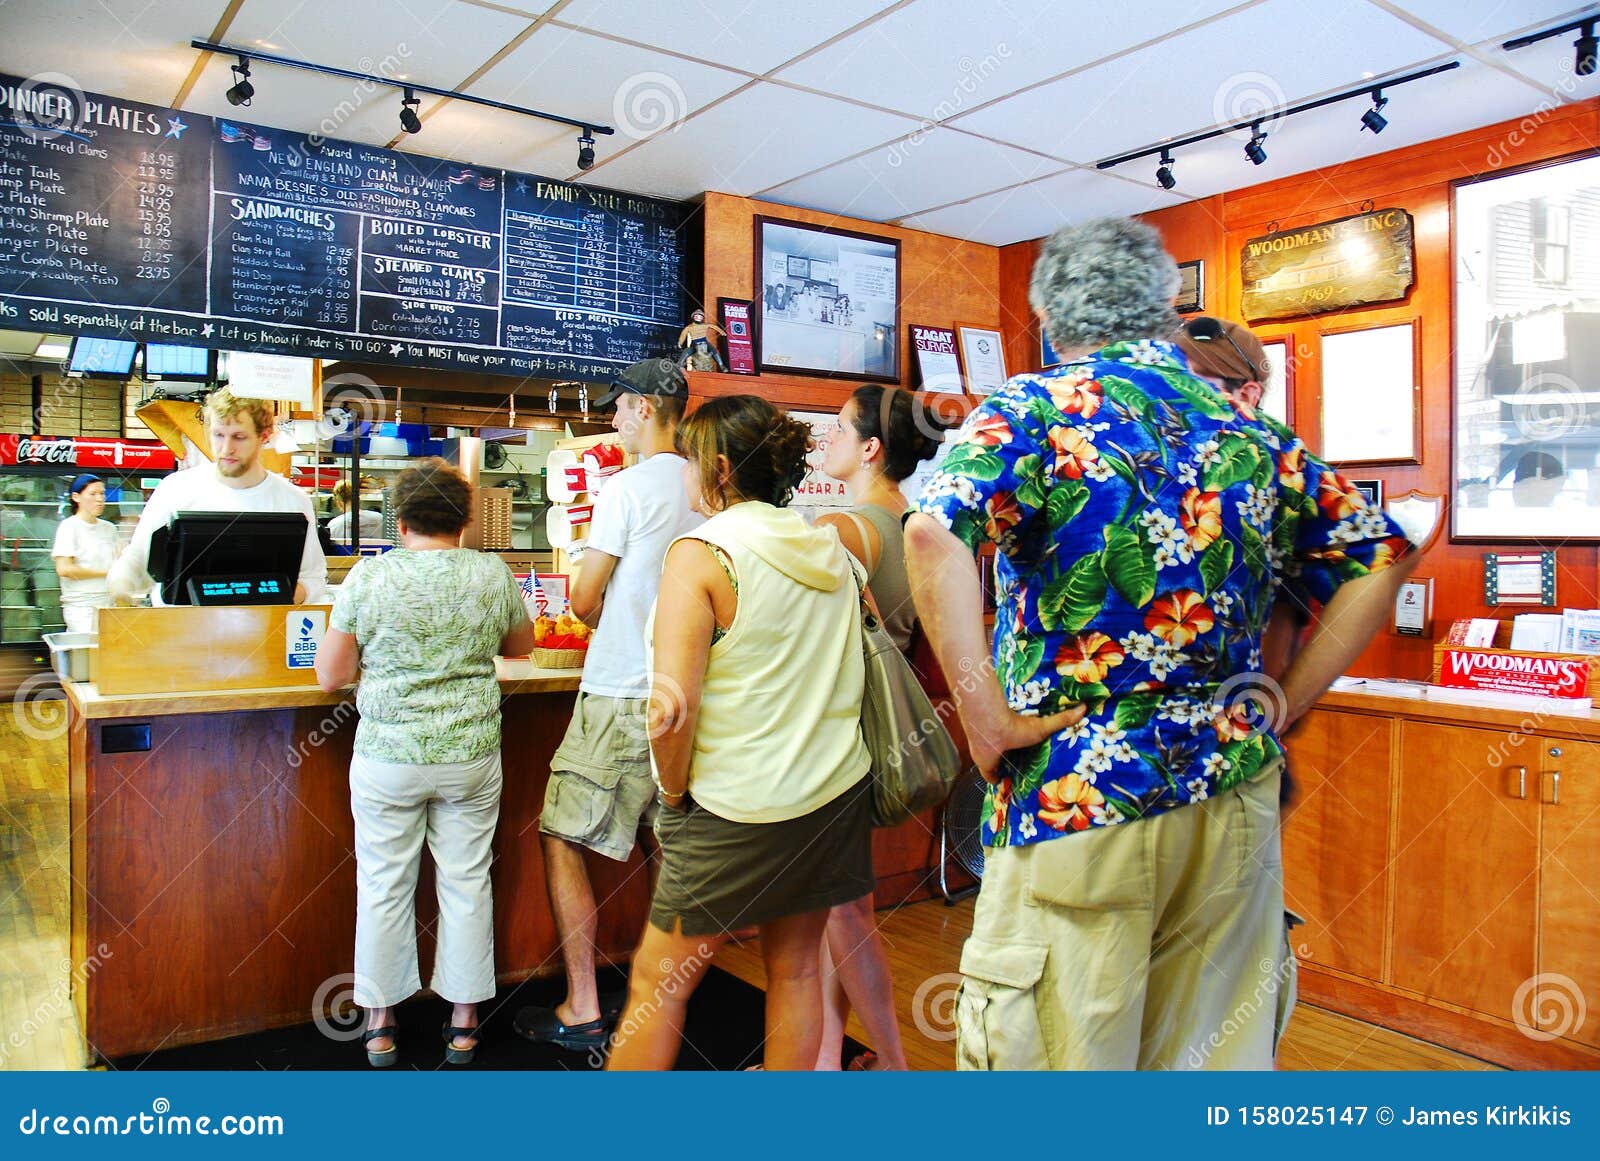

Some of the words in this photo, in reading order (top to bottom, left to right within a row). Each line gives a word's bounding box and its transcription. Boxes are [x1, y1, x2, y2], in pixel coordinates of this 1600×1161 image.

[84, 101, 162, 136] PLATES
[42, 137, 74, 154] Fried
[78, 143, 108, 160] Clams
[29, 165, 61, 181] Tails
[268, 151, 299, 167] NEW
[306, 158, 362, 178] ENGLAND
[367, 168, 398, 183] CLAM
[404, 174, 452, 193] CHOWDER
[29, 180, 66, 195] Plate
[238, 172, 271, 188] NANA
[275, 179, 329, 197] BESSIE'S
[336, 190, 358, 201] OLD
[362, 193, 421, 210] FASHIONED
[536, 182, 582, 203] FAMILY
[9, 190, 47, 206] Plate
[29, 207, 73, 228] Shrimp
[75, 210, 110, 228] Plate
[230, 198, 336, 231] SANDWICHES
[47, 223, 88, 240] Plate
[232, 232, 253, 243] Clam
[255, 233, 273, 246] Roll
[371, 219, 424, 236] BOILED
[433, 227, 492, 250] LOBSTER
[45, 238, 89, 256] Plate
[275, 247, 292, 258] Roll
[395, 244, 431, 255] MARKET
[435, 249, 461, 260] PRICE
[21, 252, 64, 268] Combo
[69, 257, 108, 274] Plate
[136, 265, 172, 279] 23.95
[232, 256, 270, 268] Haddock
[232, 267, 250, 278] Hot
[252, 269, 272, 283] Dog
[373, 257, 433, 274] STEAMED
[441, 267, 486, 284] CLAMS
[232, 279, 286, 295] Hamburger
[233, 303, 279, 316] Lobster
[283, 306, 303, 318] Roll
[291, 297, 309, 308] Roll
[402, 300, 426, 310] SIDE
[456, 316, 480, 328] 2.75
[555, 310, 582, 322] KIDS
[588, 314, 620, 327] MEALS
[371, 319, 396, 332] Corn
[456, 329, 480, 339] 2.75
[914, 328, 952, 344] ZAGAT
[29, 307, 59, 323] sold
[63, 312, 128, 332] separately
[130, 315, 145, 331] at
[149, 318, 169, 335] the
[173, 320, 198, 337] bar
[220, 325, 239, 339] Let
[244, 331, 257, 343] us
[335, 337, 345, 349] is
[408, 345, 424, 357] You
[428, 346, 453, 360] MUST
[457, 350, 480, 364] have
[483, 356, 506, 368] your
[511, 357, 541, 373] receipt
[545, 358, 556, 370] to
[558, 360, 576, 373] pick
[591, 364, 612, 378] your
[917, 340, 954, 354] SURVEY
[838, 484, 845, 496] A
[294, 642, 317, 652] BBB
[1450, 650, 1582, 686] WOODMAN'S
